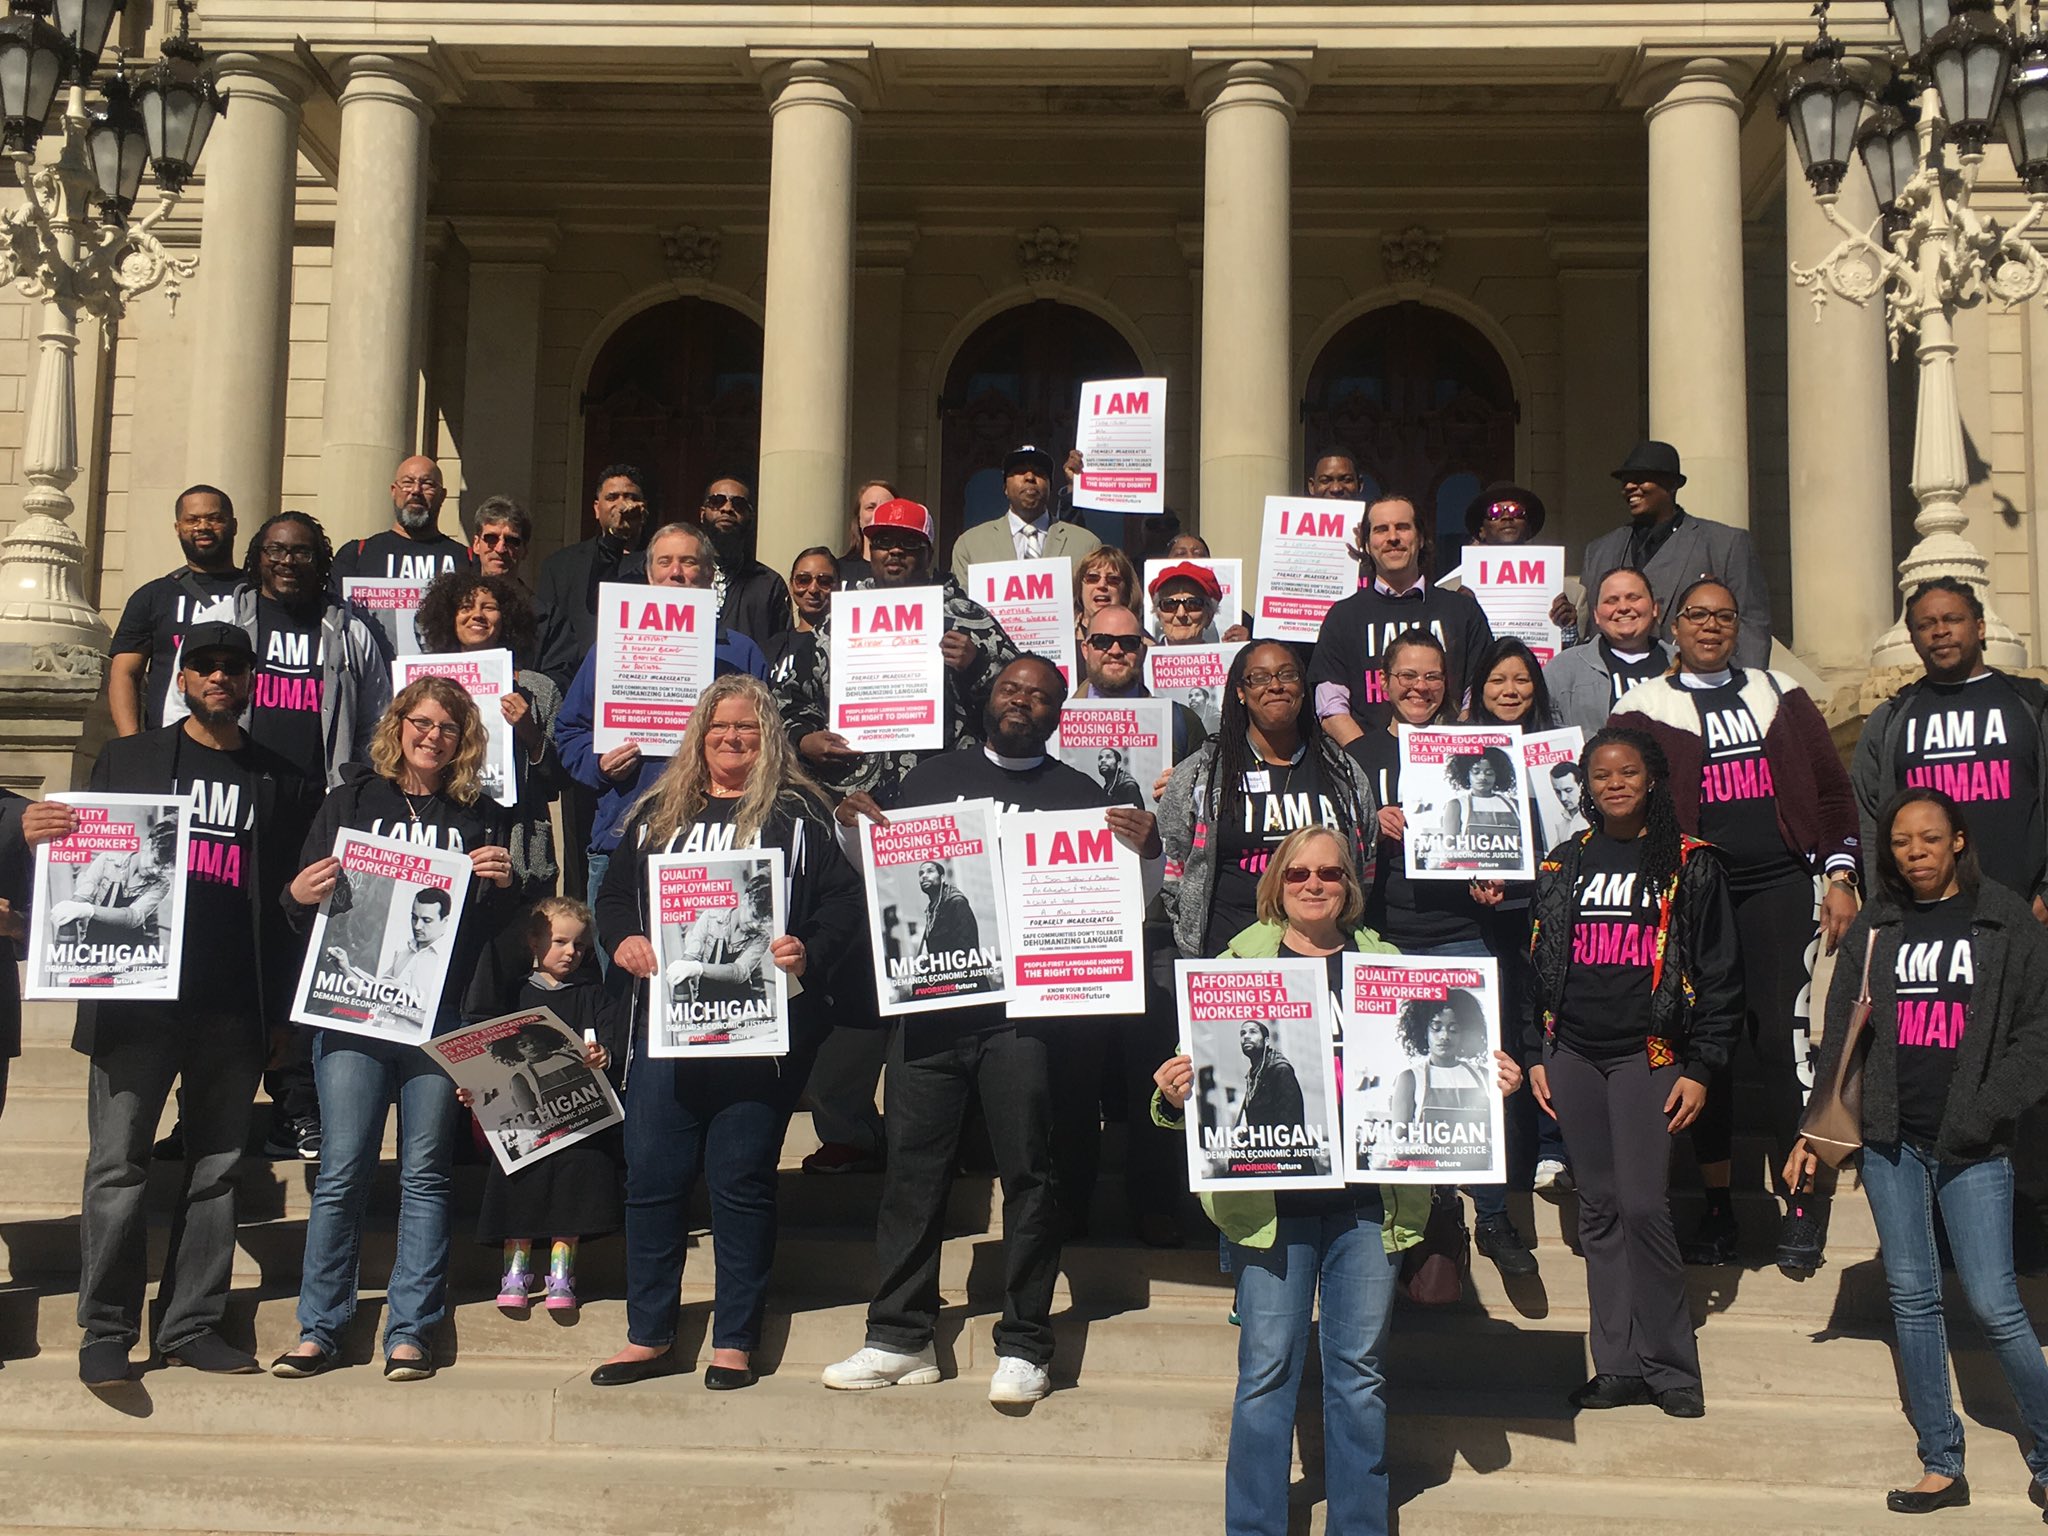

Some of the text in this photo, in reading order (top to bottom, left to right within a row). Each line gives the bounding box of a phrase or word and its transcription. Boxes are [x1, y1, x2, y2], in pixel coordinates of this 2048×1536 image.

[1094, 391, 1149, 415] I AM
[1280, 511, 1345, 538] I AM
[400, 554, 435, 578] AM
[1480, 560, 1545, 584] I AM
[354, 588, 416, 598] HEALING IS A
[987, 573, 1054, 602] I AM
[1271, 586, 1313, 594] DEHUMANIZING
[620, 601, 695, 633] I AM
[852, 603, 923, 634] I AM
[1282, 607, 1303, 615] RIGHT
[266, 630, 309, 666] AM
[1155, 655, 1218, 667] AFFORDABLE
[409, 664, 476, 676] AFFORDABLE
[1156, 665, 1222, 677] HOUSING IS A
[459, 675, 469, 684] IS
[471, 674, 479, 683] A
[1156, 677, 1207, 688] WORKER'S
[612, 689, 662, 698] DEHUMANIZING
[663, 691, 697, 700] LANGUAGE
[846, 689, 893, 698] DEHUMANIZING
[894, 687, 928, 695] LANGUAGE
[611, 714, 663, 724] THE RIGHT TO
[861, 713, 884, 722] RIGHT
[885, 712, 895, 720] TO
[897, 711, 927, 719] DIGNITY
[1062, 711, 1133, 723] AFFORDABLE
[1062, 722, 1136, 735] HOUSING IS A
[1705, 708, 1758, 749] AM
[1906, 708, 2008, 754] I AM A
[857, 733, 915, 741] #WORKINGfuture
[1062, 735, 1155, 747] WORKER'S RIGHT
[1409, 734, 1507, 745] QUALITY EDUCATION
[1410, 744, 1480, 754] IS A WORKER'S
[1411, 754, 1440, 763] RIGHT
[1538, 751, 1571, 765] RIGHT
[1906, 759, 2010, 803] HUMAN
[189, 778, 241, 828] AM
[1263, 792, 1313, 832] AM
[874, 816, 953, 839] AFFORDABLE
[76, 837, 138, 849] WORKER'S
[876, 830, 957, 851] HOUSING IS A
[1025, 828, 1113, 867] I AM
[1418, 835, 1518, 851] MICHIGAN
[51, 851, 87, 862] RIGHT
[347, 843, 426, 870] HEALING IS A
[877, 842, 980, 865] WORKER'S RIGHT
[1453, 851, 1519, 859] ECONOMIC JUSTICE
[343, 856, 409, 880] WORKER'S
[410, 870, 449, 889] RIGHT
[661, 869, 703, 882] QUALITY
[662, 880, 731, 895] EMPLOYMENT
[1580, 872, 1637, 906] AM
[662, 894, 737, 908] IS A WORKER'S
[662, 910, 693, 922] RIGHT
[1029, 916, 1114, 926] FORMERLY INCARCERATED
[1023, 937, 1082, 947] DEHUMANIZING
[1083, 935, 1123, 943] LANGUAGE
[1037, 931, 1077, 939] COMMUNITIES
[46, 943, 164, 964] MICHIGAN
[890, 946, 997, 978] MICHIGAN
[1023, 960, 1064, 969] PEOPLE-FIRST
[1065, 959, 1097, 967] LANGUAGE
[1895, 939, 1974, 985] AM A
[891, 967, 999, 987] DEMANDS ECONOMIC JUSTICE
[1024, 966, 1124, 979] THE RIGHT TO DIGNITY
[1356, 969, 1477, 985] QUALITY EDUCATION
[315, 970, 423, 1008] MICHIGAN
[1192, 974, 1279, 989] AFFORDABLE
[1040, 992, 1111, 1002] #WORKINGfuture
[1193, 989, 1284, 1004] HOUSING IS A
[1356, 985, 1443, 998] IS A WORKER'S
[312, 990, 390, 1013] DEMANDS ECONOMIC
[1356, 1001, 1392, 1013] RIGHT
[666, 999, 772, 1022] MICHIGAN
[1194, 1004, 1309, 1020] WORKER'S RIGHT
[437, 1014, 540, 1052] QUALITY EDUCATION
[465, 1028, 518, 1050] WORKER'S
[451, 1049, 480, 1064] RIGHT
[1204, 1124, 1323, 1149] MICHIGAN
[1362, 1121, 1486, 1144] MICHIGAN
[1205, 1148, 1325, 1160] DEMANDS ECONOMIC JUSTICE
[1404, 1145, 1487, 1155] ECONOMIC JUSTICE
[1231, 1162, 1302, 1172] #WORKINGfuture
